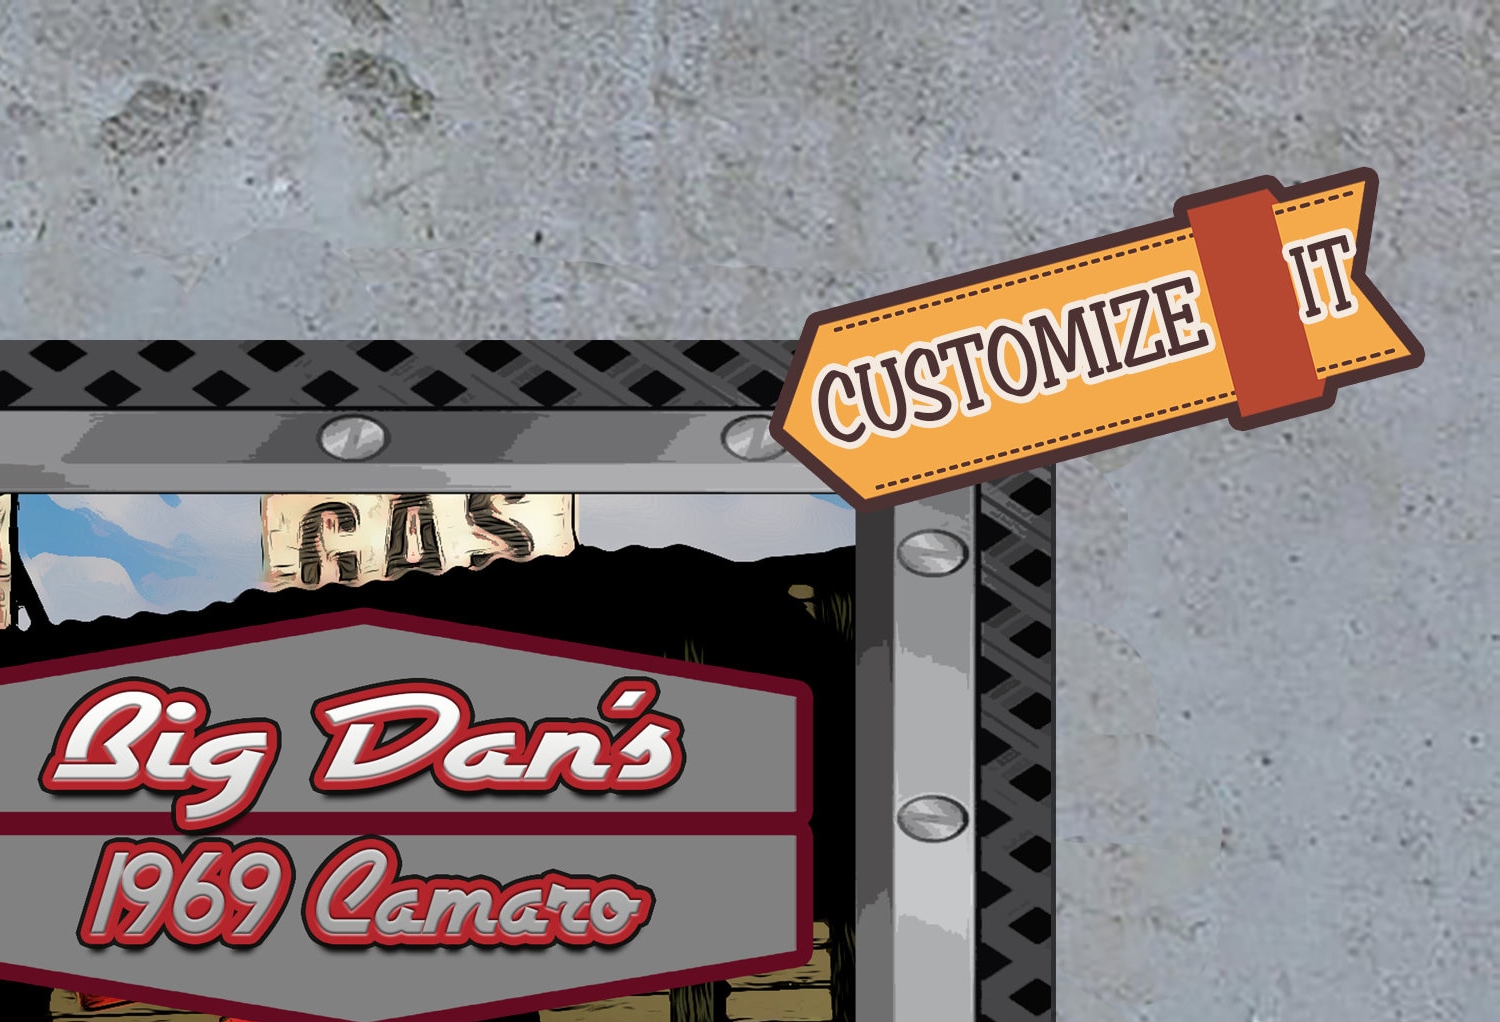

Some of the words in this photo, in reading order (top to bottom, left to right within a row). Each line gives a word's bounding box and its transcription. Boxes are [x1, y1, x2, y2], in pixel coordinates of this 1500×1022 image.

[46, 682, 276, 829] Big
[316, 683, 680, 788] Dan's
[83, 845, 289, 942] 1969
[307, 841, 649, 941] Camaro
